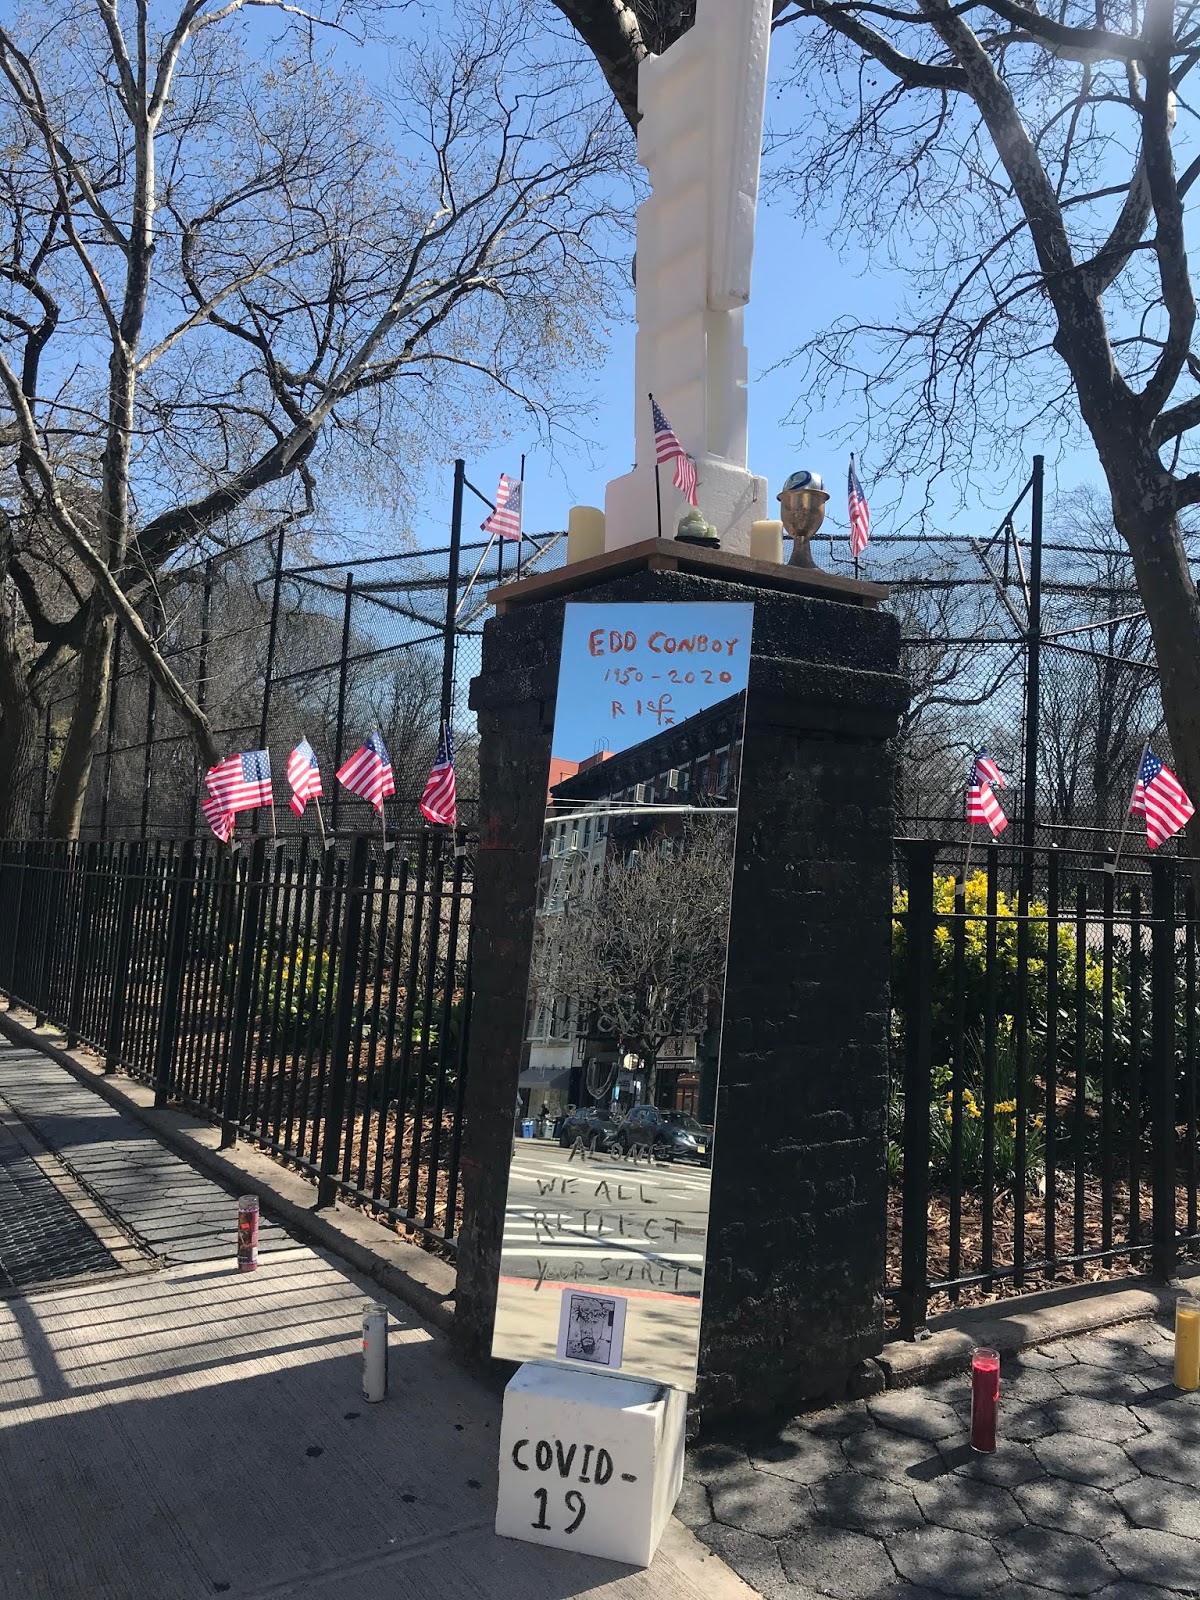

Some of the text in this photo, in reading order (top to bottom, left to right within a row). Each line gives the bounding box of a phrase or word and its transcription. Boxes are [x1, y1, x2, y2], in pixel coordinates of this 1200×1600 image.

[588, 628, 739, 657] EDD CONBOY
[536, 1177, 657, 1204] WE ALL
[598, 1257, 689, 1290] SPIRIT
[531, 1487, 587, 1534] 19
